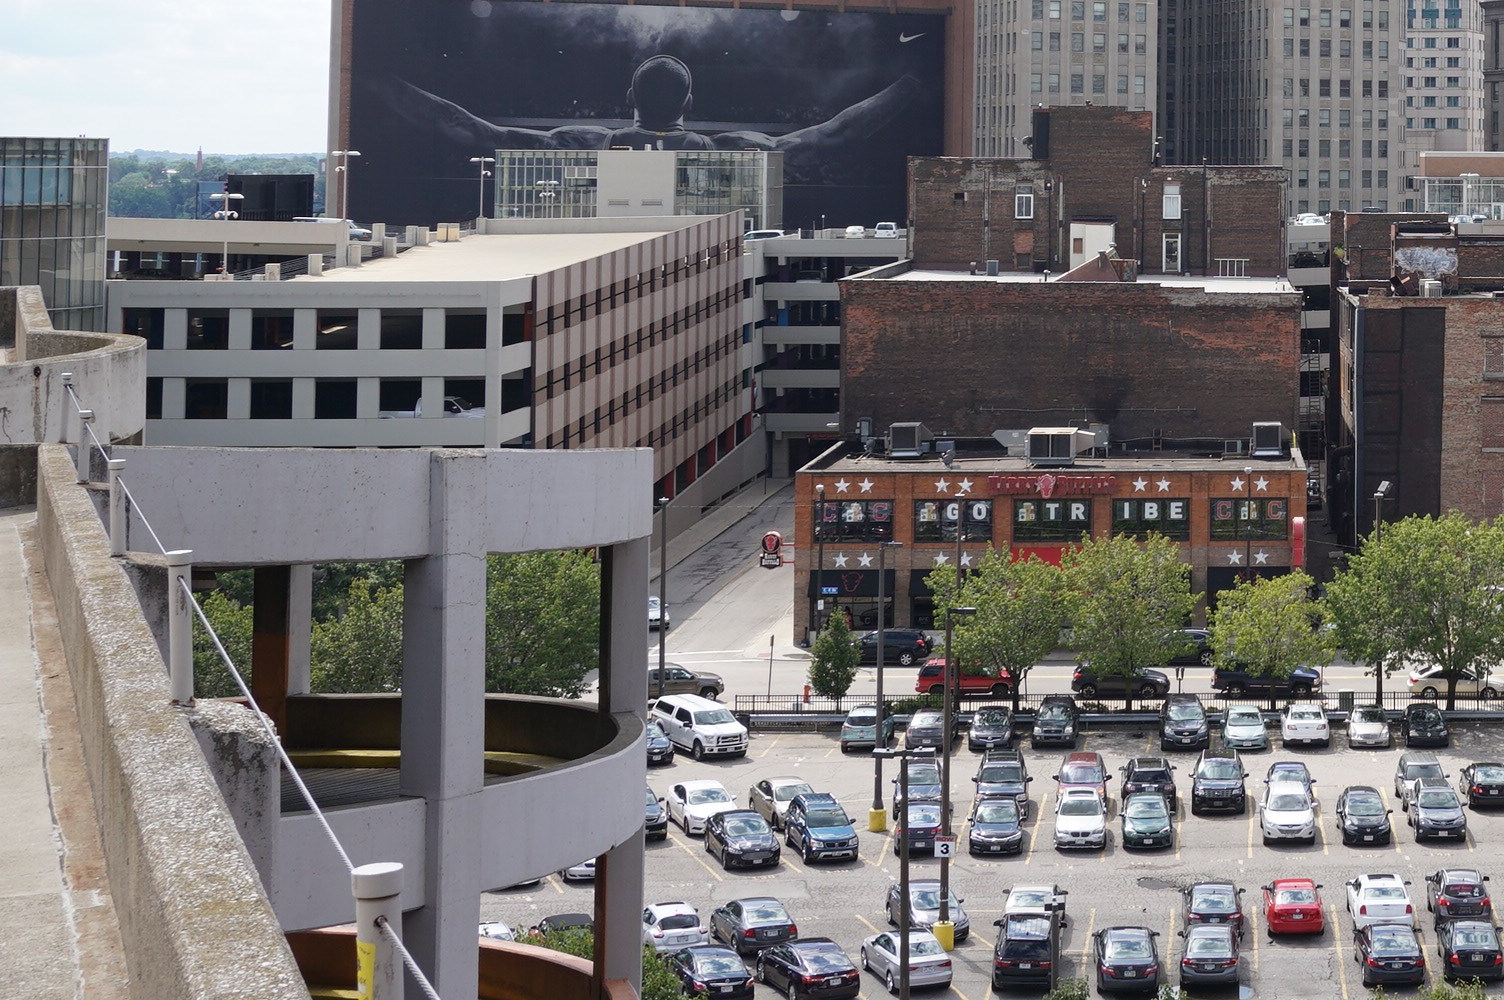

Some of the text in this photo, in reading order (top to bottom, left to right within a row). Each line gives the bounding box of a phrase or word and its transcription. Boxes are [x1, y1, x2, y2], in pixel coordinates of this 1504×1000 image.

[872, 503, 889, 521] C
[946, 503, 988, 521] GO
[1216, 501, 1283, 519] C C
[941, 844, 949, 854] 3
